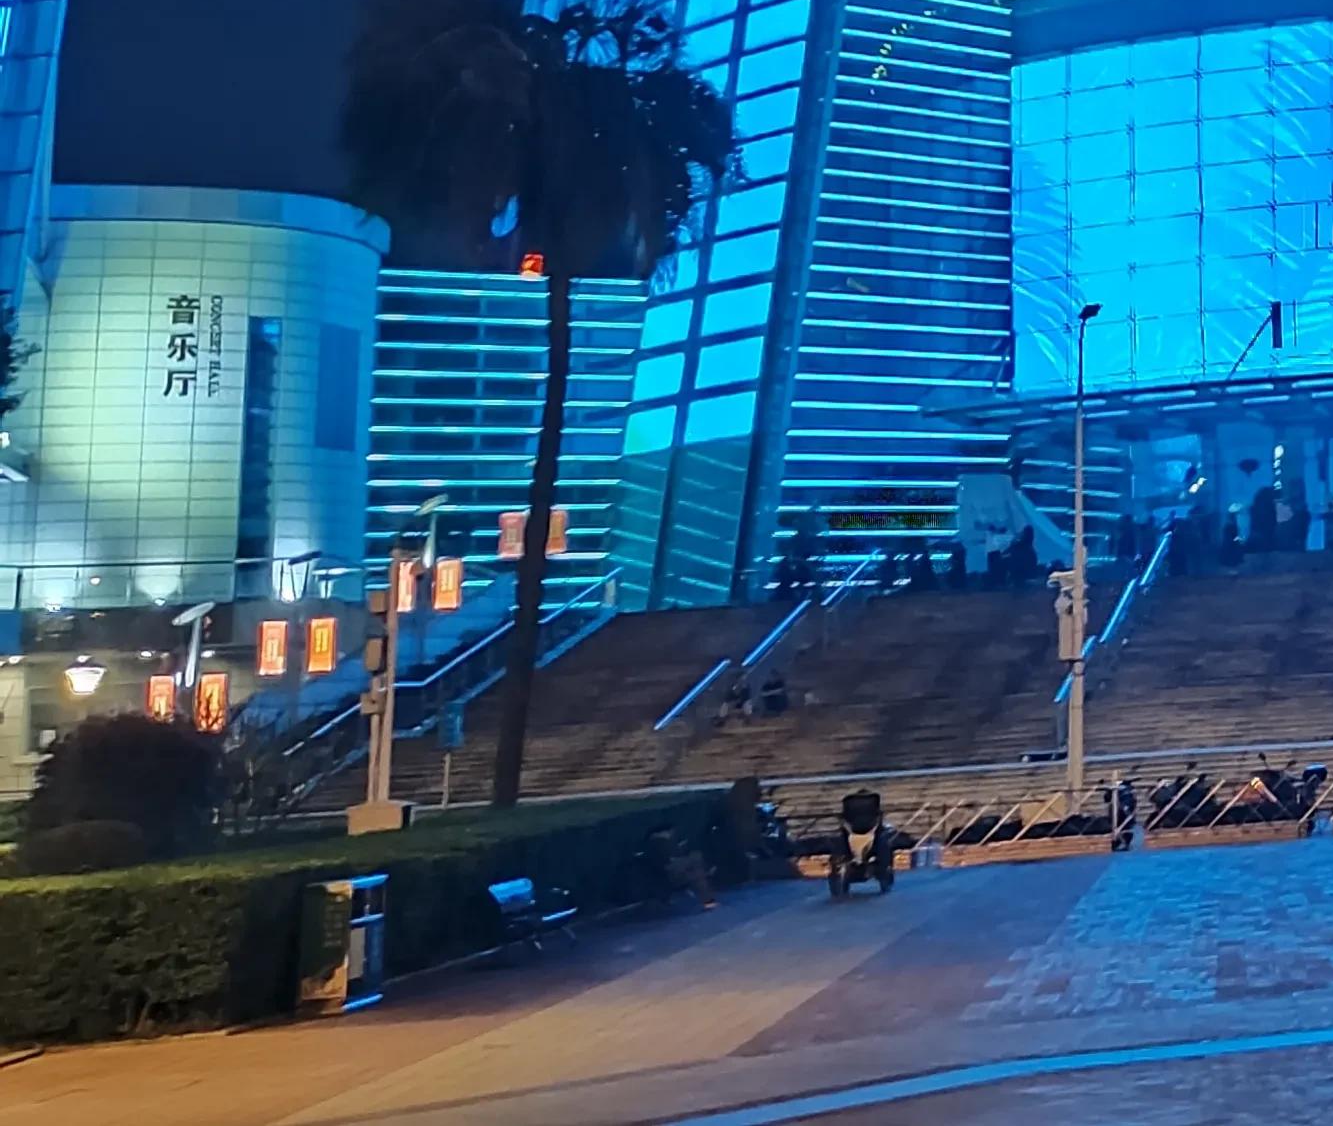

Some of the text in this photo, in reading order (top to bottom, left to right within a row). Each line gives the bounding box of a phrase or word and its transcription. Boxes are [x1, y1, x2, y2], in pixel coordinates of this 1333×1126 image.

[164, 294, 200, 396] 音乐厅
[207, 295, 223, 397] CONCERT HALL
